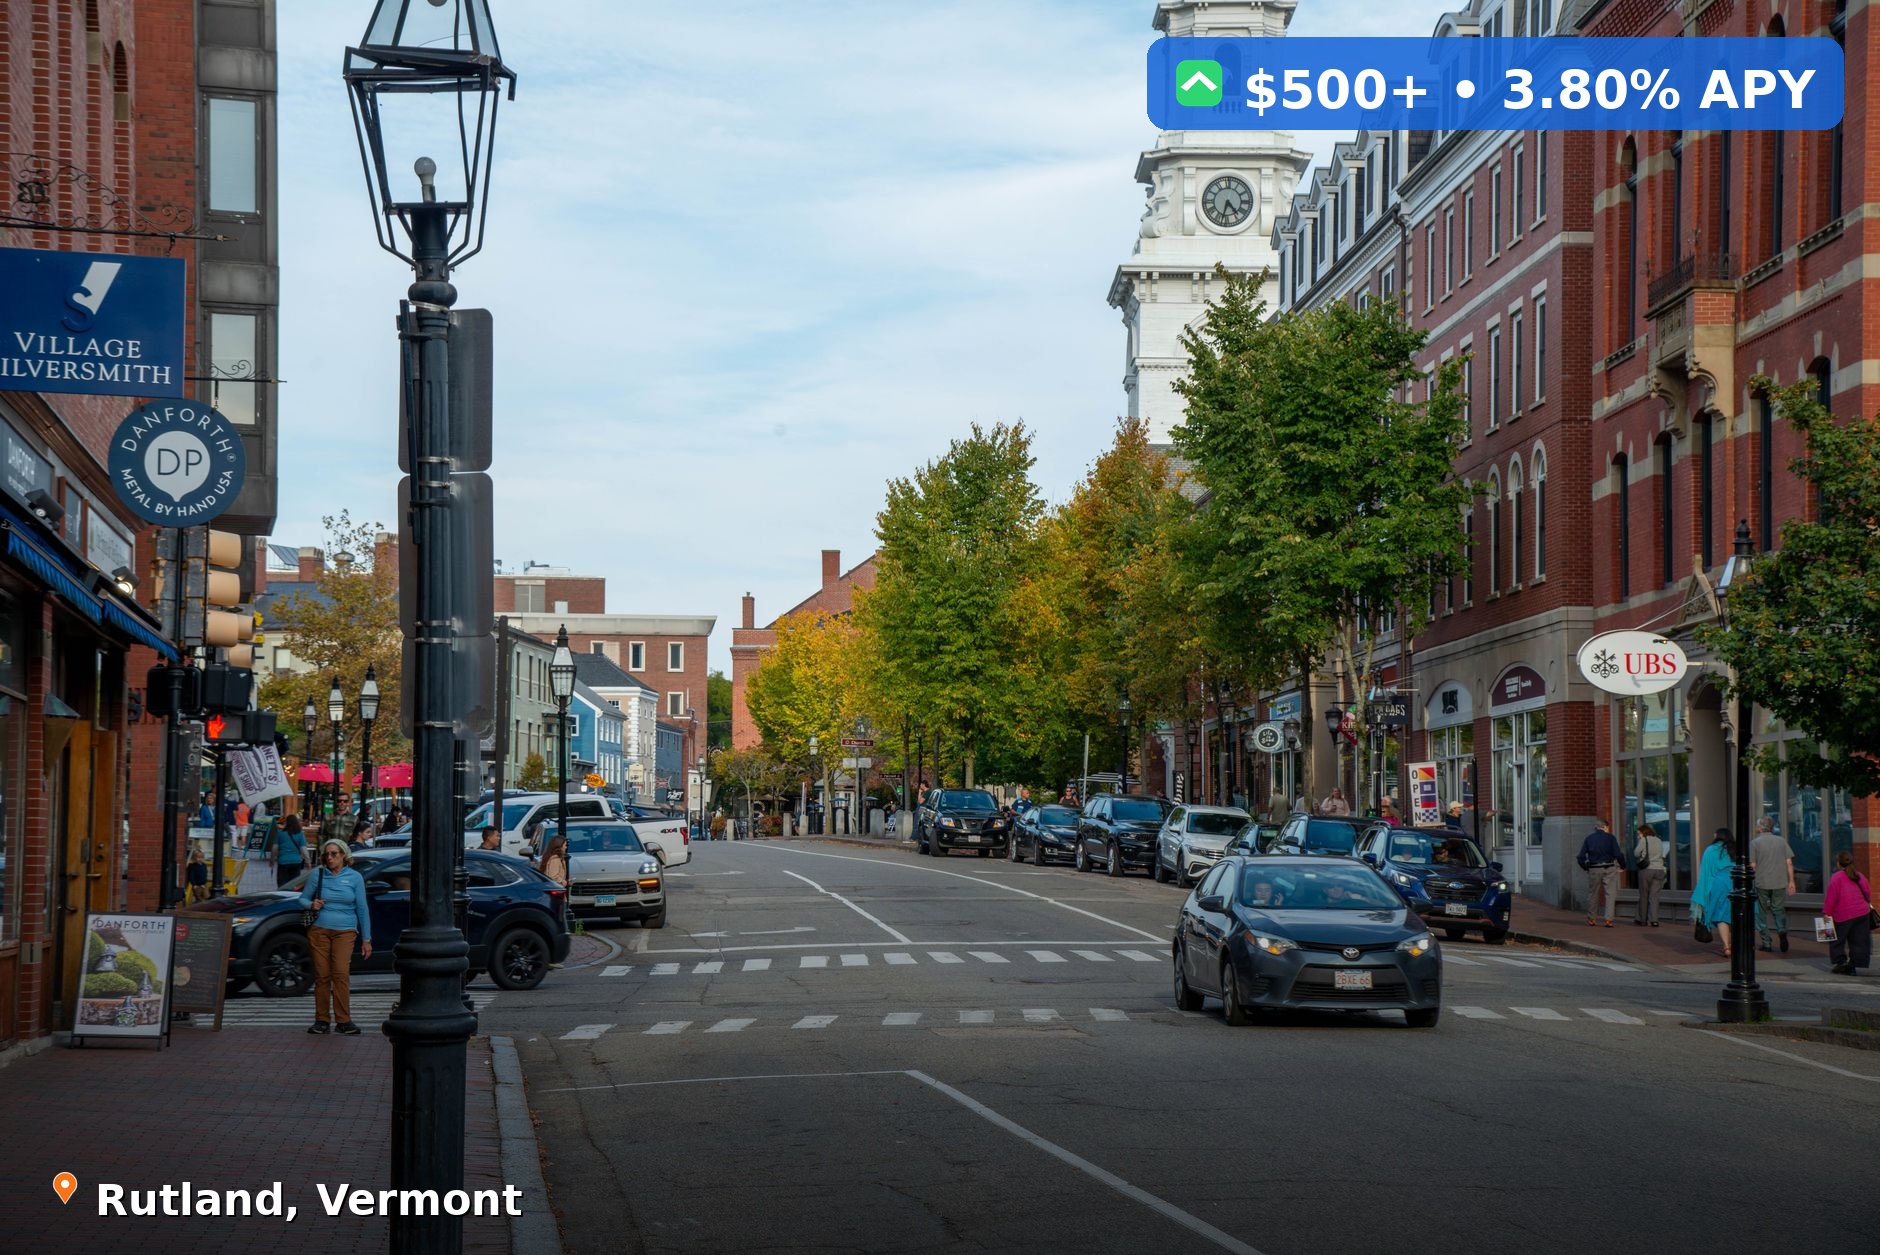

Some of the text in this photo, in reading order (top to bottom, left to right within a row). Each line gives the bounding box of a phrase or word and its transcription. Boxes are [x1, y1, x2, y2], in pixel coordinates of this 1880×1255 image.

[14, 331, 142, 359] VILLAGE
[0, 357, 171, 385] ILVERSMITH
[121, 407, 233, 452] DANFORTH
[157, 448, 203, 477] DP
[121, 468, 234, 517] METAL BY HAND USA
[1623, 652, 1677, 675] UBS
[1411, 769, 1422, 821] OPEN
[96, 919, 166, 930] DANFORTH
